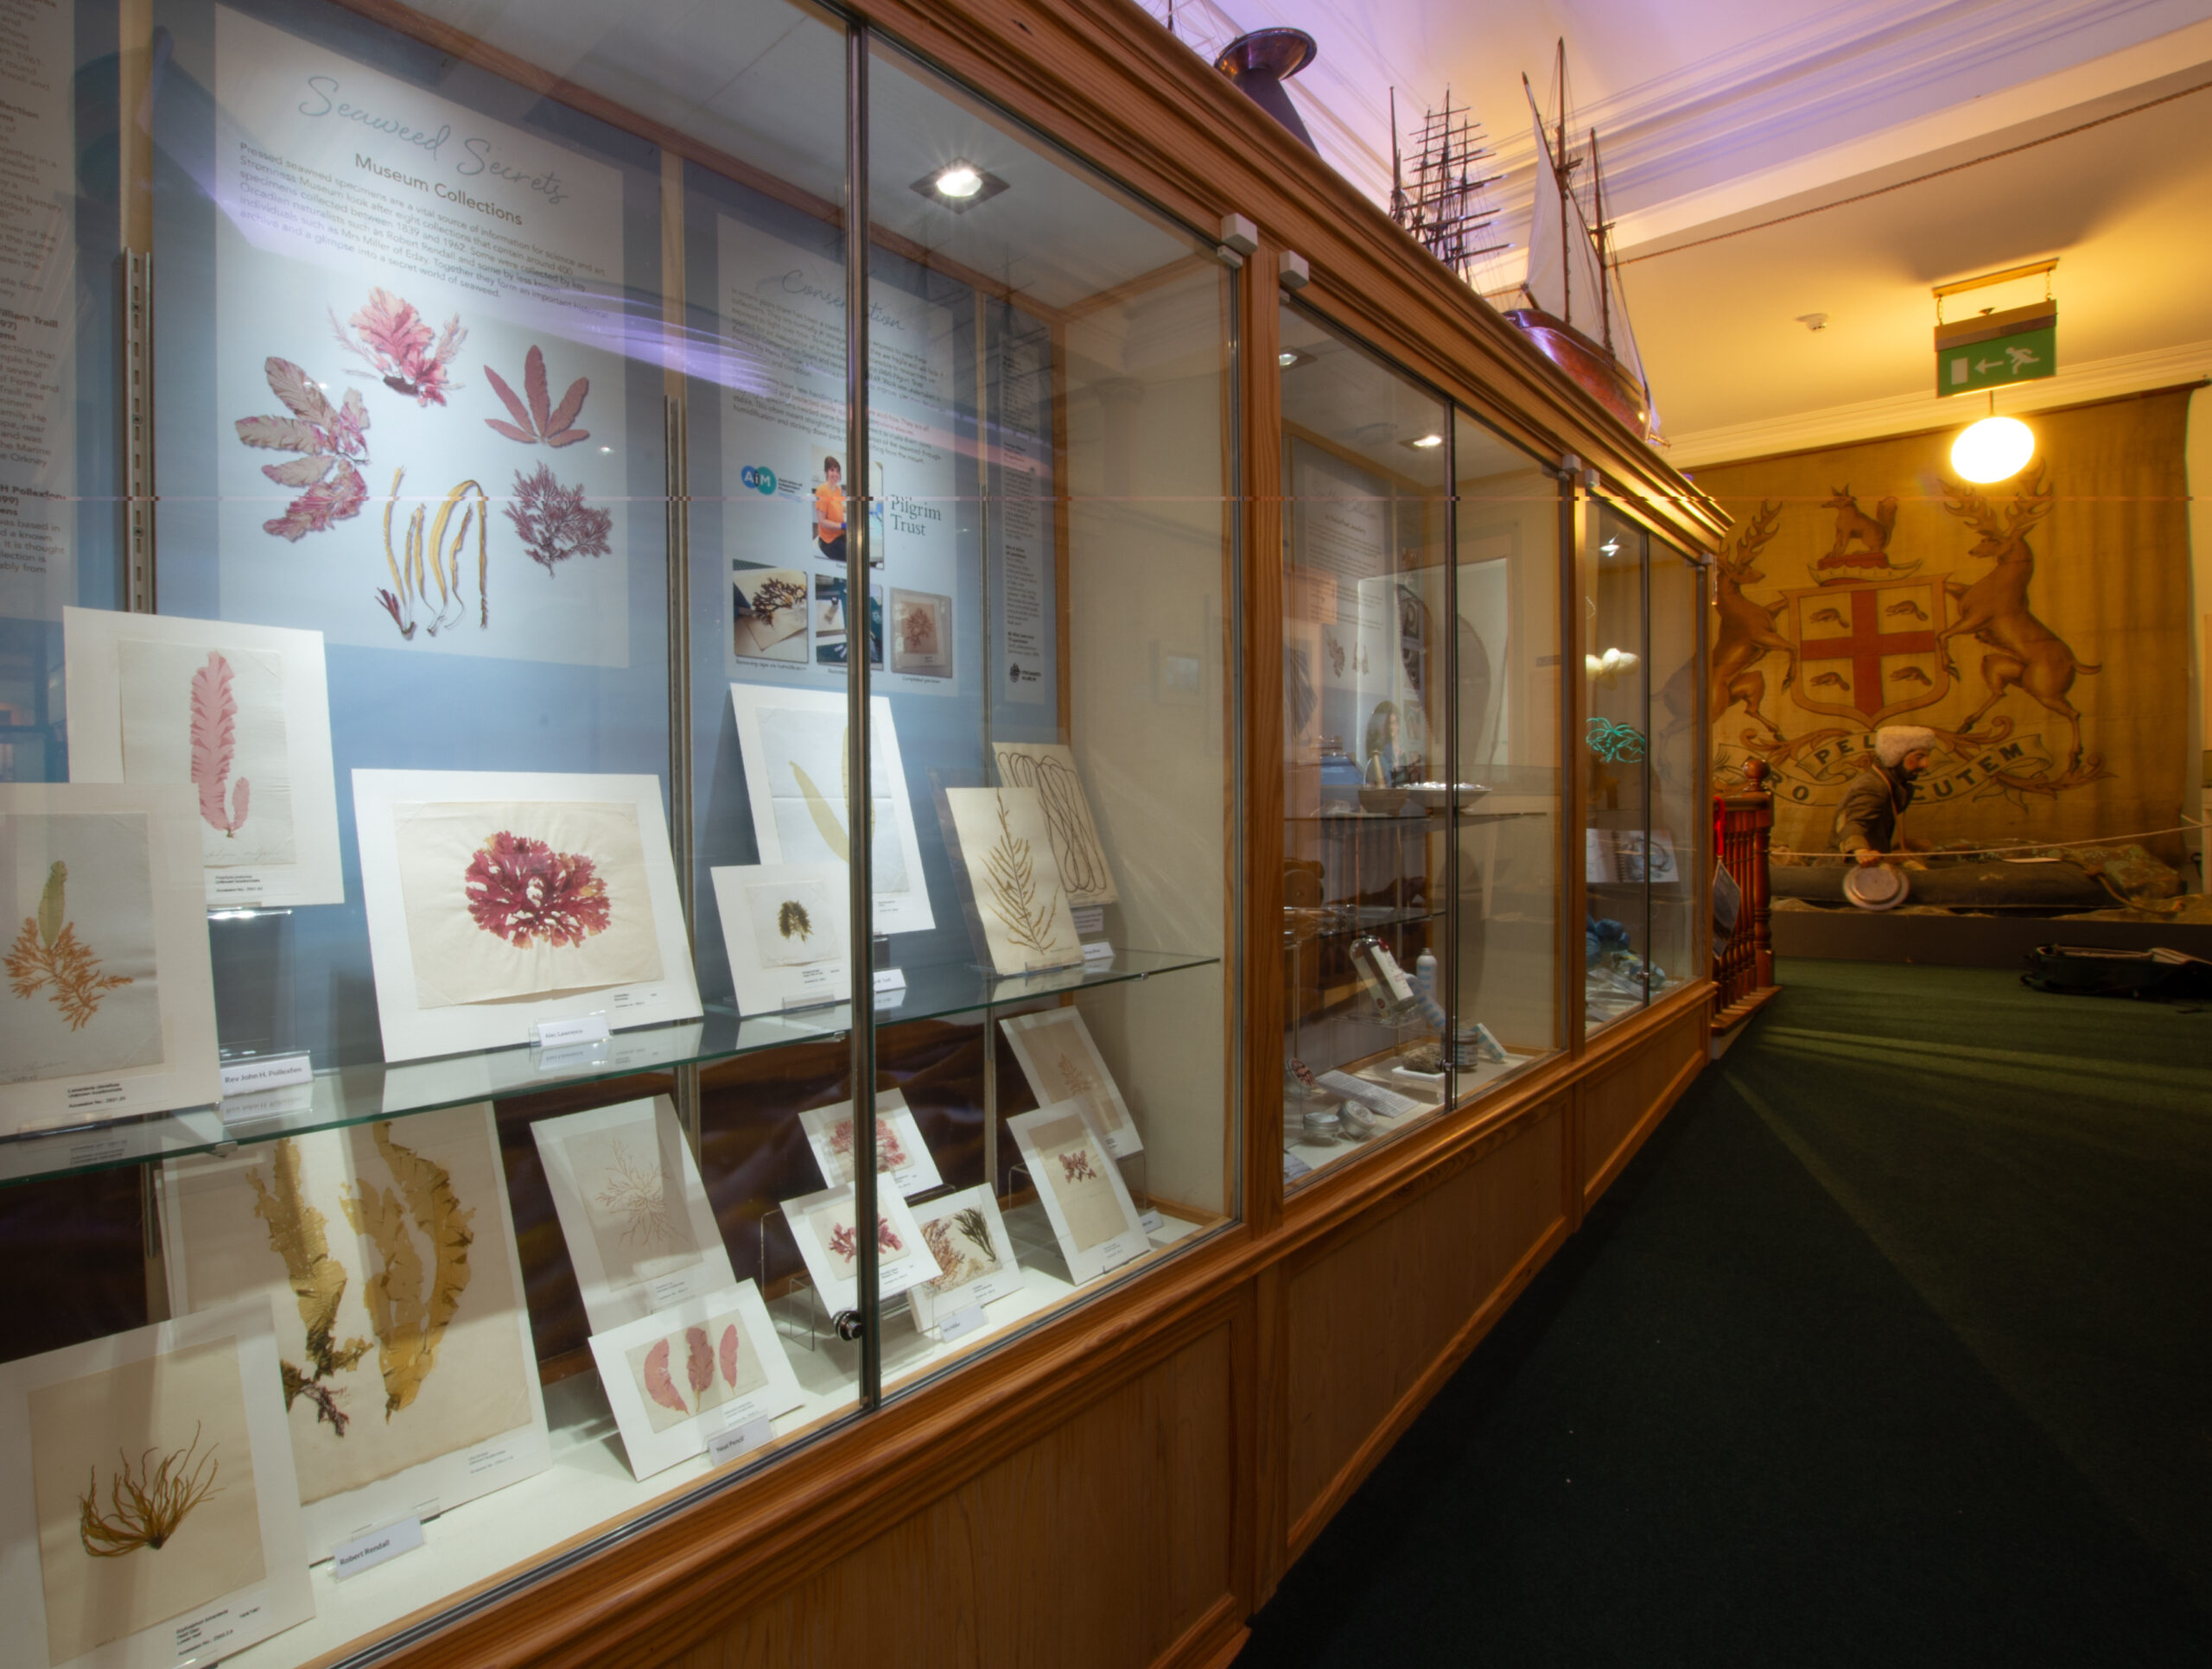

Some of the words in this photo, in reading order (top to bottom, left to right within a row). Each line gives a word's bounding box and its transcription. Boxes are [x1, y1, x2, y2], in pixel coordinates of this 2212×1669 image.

[299, 75, 451, 160] Seaweed
[456, 138, 569, 205] Secrets
[354, 153, 429, 193] Museum
[434, 182, 523, 225] Collections
[240, 143, 283, 165] Pressed
[286, 159, 331, 181] seaweed
[334, 176, 385, 203] specimens
[389, 197, 404, 206] are
[416, 205, 434, 218] vital
[437, 214, 465, 228] source
[469, 224, 478, 232] of
[481, 227, 529, 250] information
[531, 245, 542, 255] for
[545, 250, 574, 266] science
[578, 261, 592, 272] and
[240, 156, 295, 182] Stromness
[300, 177, 343, 198] Museum
[346, 193, 368, 206] look
[372, 201, 392, 215] after
[396, 210, 419, 226] eight
[423, 219, 470, 241] collections
[474, 237, 490, 248] that
[493, 243, 523, 259] contain
[525, 254, 555, 270] around
[240, 169, 297, 198] specimens
[300, 190, 346, 212] collected
[351, 206, 392, 227] between
[397, 222, 419, 236] 1839
[423, 231, 439, 243] and
[444, 238, 465, 251] 1962.
[470, 247, 494, 261] Some
[499, 258, 518, 269] were
[521, 263, 556, 282] collected
[560, 277, 569, 288] by
[572, 281, 585, 293] key
[240, 183, 289, 206] Orcadian
[293, 200, 345, 224] naturalists
[347, 219, 369, 232] such
[373, 228, 384, 237] as
[387, 232, 417, 247] Robert
[421, 243, 453, 259] Rendall
[458, 255, 474, 266] and
[478, 263, 499, 274] some
[503, 270, 513, 281] by
[517, 274, 531, 284] less
[534, 279, 560, 294] known
[240, 196, 297, 221] individuals
[301, 216, 323, 230] such
[341, 229, 359, 241] Mrs
[363, 236, 390, 251] Miller
[393, 245, 402, 255] of
[406, 250, 429, 266] Eday.
[434, 258, 473, 279] Together
[476, 272, 493, 286] they
[497, 279, 517, 291] form
[532, 290, 570, 310] important
[240, 210, 279, 229] archive
[282, 223, 302, 236] and
[315, 233, 354, 254] glimpse
[358, 246, 377, 259] into
[389, 257, 416, 271] secret
[420, 266, 444, 280] world
[448, 275, 456, 283] of
[460, 278, 500, 297] seaweed.
[33, 315, 59, 328] Traill
[6, 365, 42, 379] several
[10, 375, 37, 390] Forth
[41, 384, 60, 394] and
[25, 391, 44, 402] was
[32, 413, 48, 423] He
[22, 422, 44, 433] near
[23, 435, 42, 444] was
[16, 441, 52, 456] Marine
[10, 451, 48, 468] Orkney
[891, 493, 942, 522] Pilgrim
[17, 520, 49, 531] based
[51, 524, 60, 533] in
[890, 513, 926, 536] Trust
[19, 530, 53, 543] known
[25, 543, 66, 555] thought
[22, 564, 47, 574] from
[269, 1067, 302, 1077] Pollexfen
[340, 1551, 364, 1566] Robert
[364, 1539, 391, 1556] Rendall
